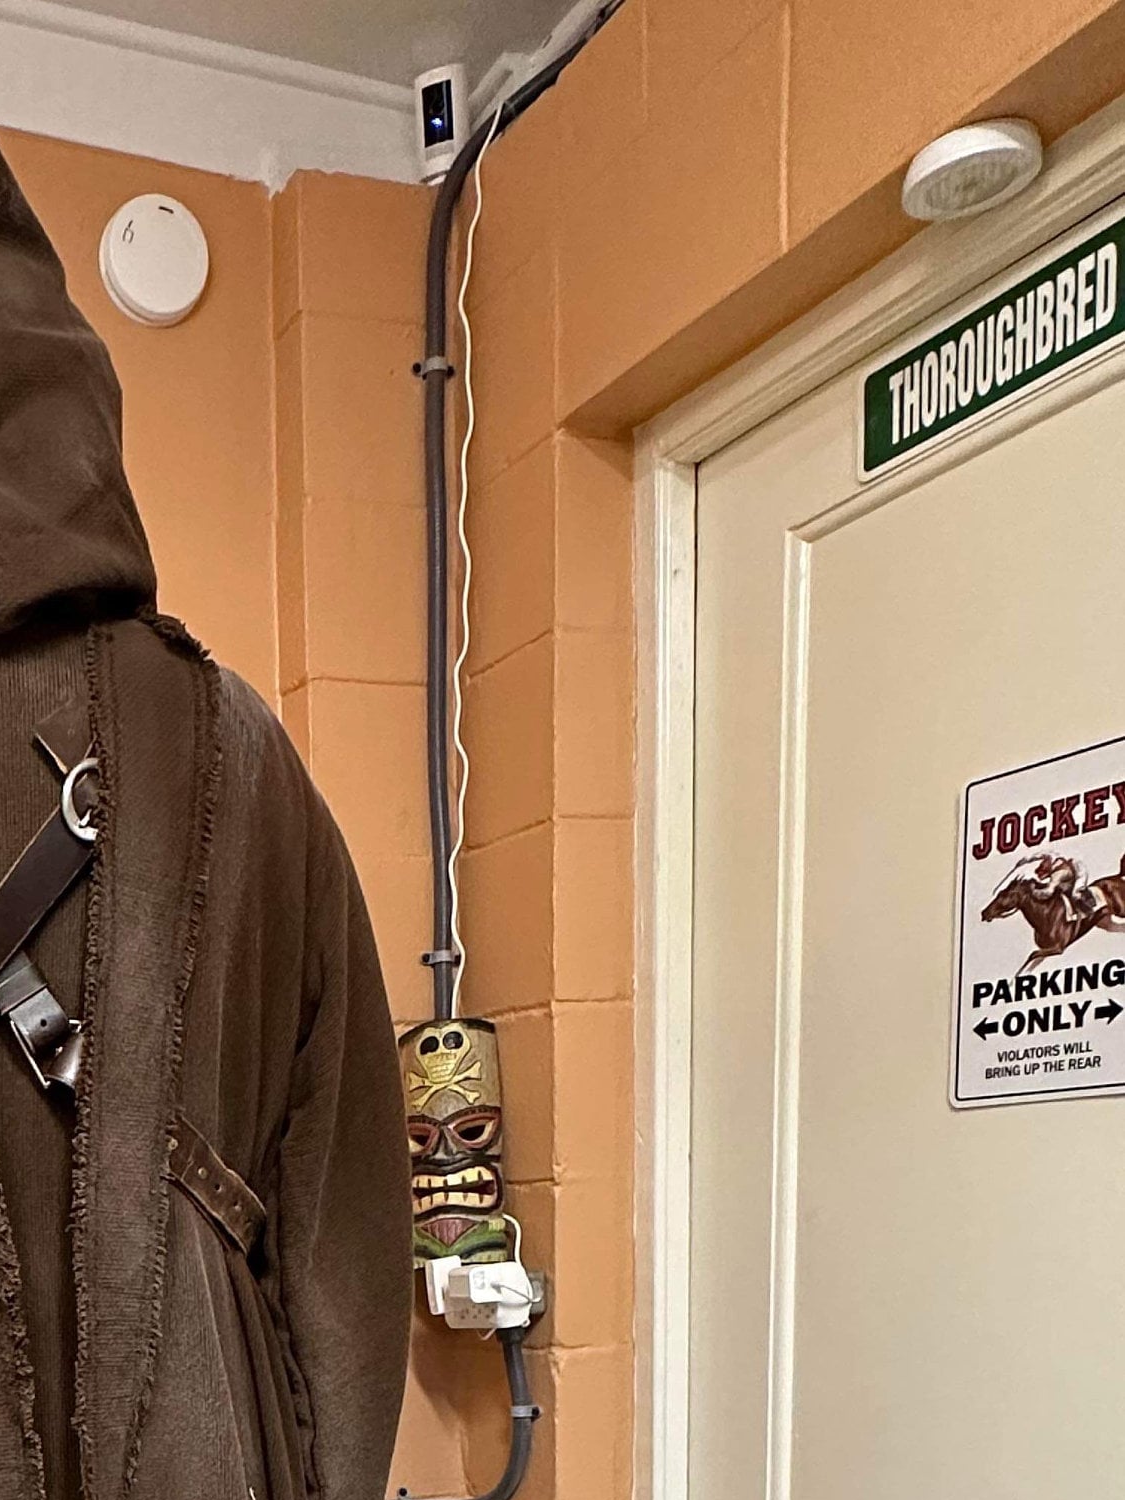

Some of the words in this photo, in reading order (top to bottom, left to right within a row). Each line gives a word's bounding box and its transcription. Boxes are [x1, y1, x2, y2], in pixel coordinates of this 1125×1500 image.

[889, 242, 1118, 445] THOROUGHBRED
[972, 959, 1125, 1009] PARKING
[1002, 1000, 1092, 1037] ONLY
[985, 1064, 1020, 1079] BRING
[1024, 1062, 1040, 1075] UP
[1042, 1059, 1065, 1073] THE
[1068, 1055, 1101, 1070] REAR
[997, 1044, 1060, 1063] VIOLATORS
[1063, 1040, 1093, 1055] WILL
